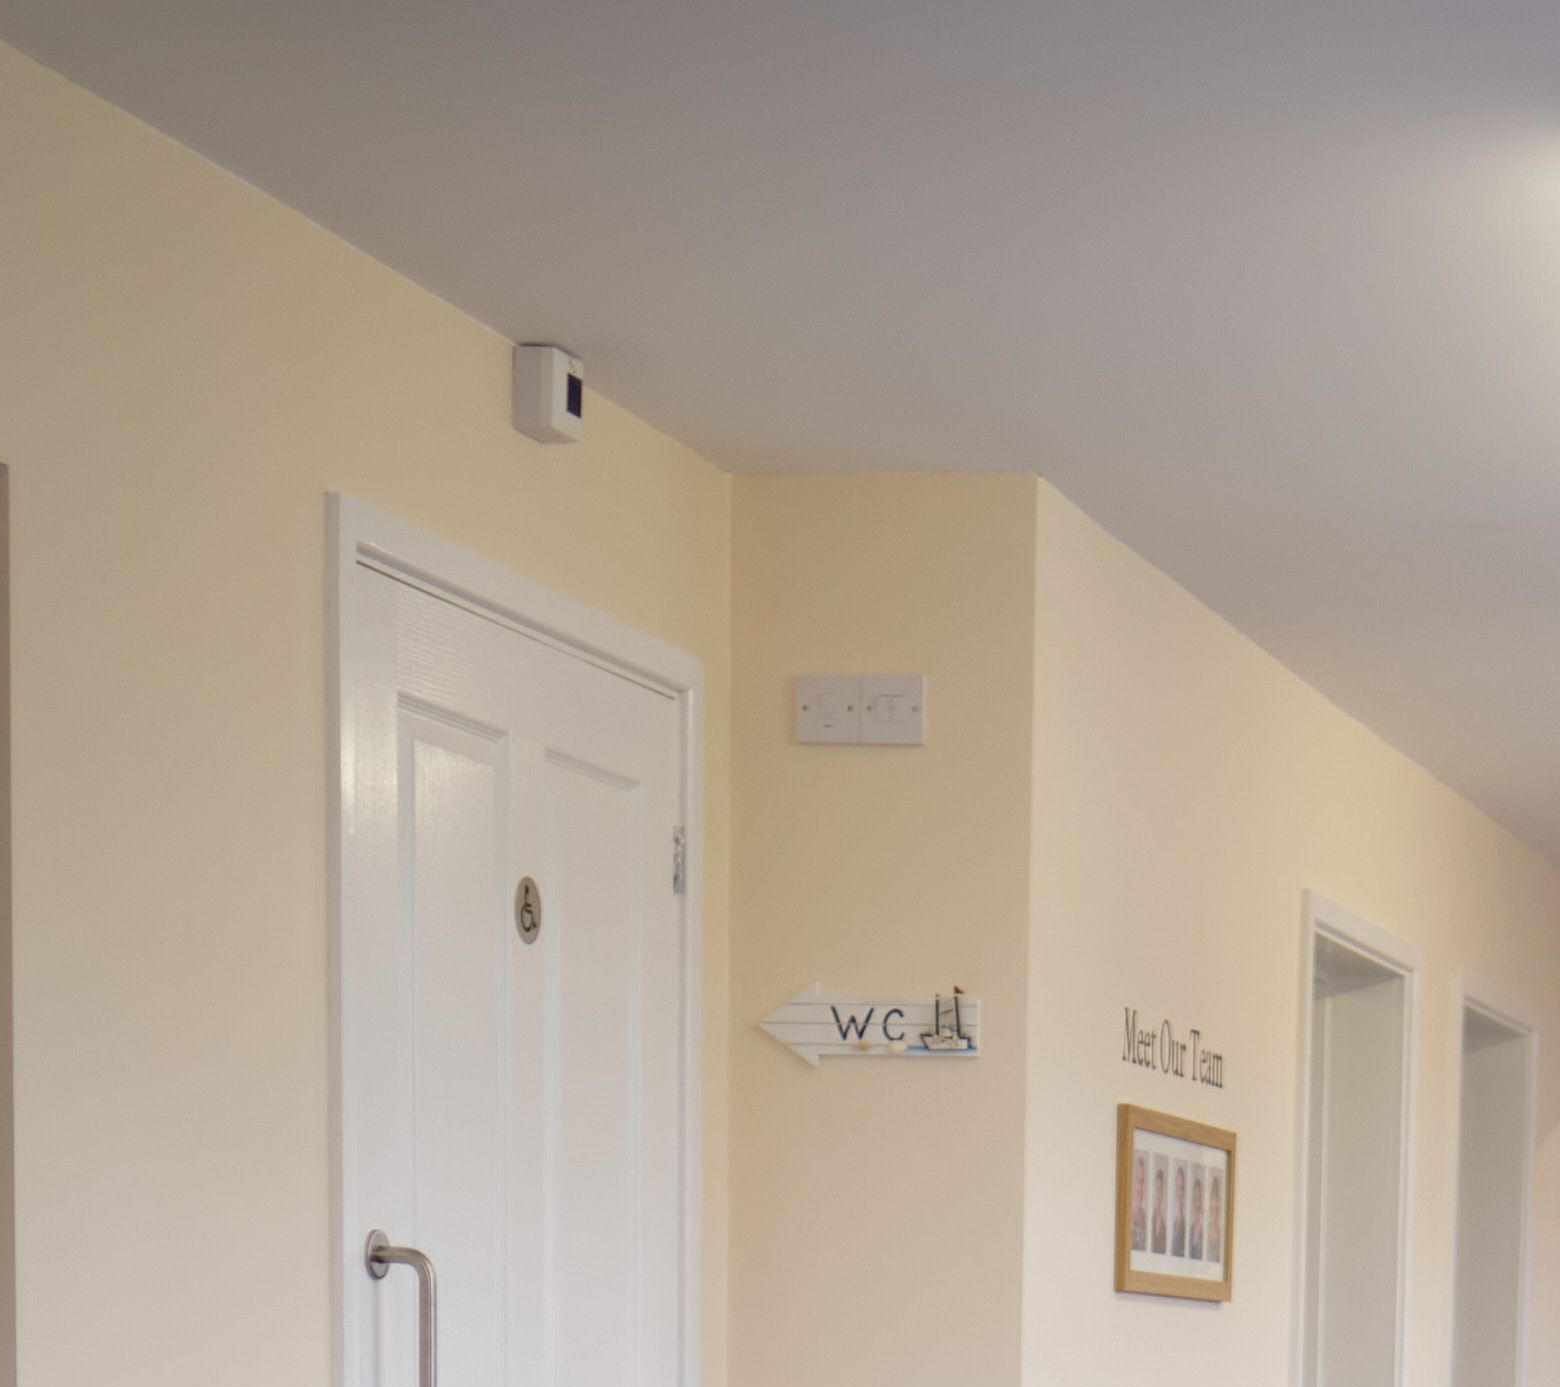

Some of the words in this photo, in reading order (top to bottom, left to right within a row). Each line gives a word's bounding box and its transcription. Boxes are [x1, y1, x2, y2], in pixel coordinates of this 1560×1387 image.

[1122, 1006, 1157, 1070] Meet
[1160, 1019, 1187, 1078] Our
[1189, 1028, 1224, 1088] Team
